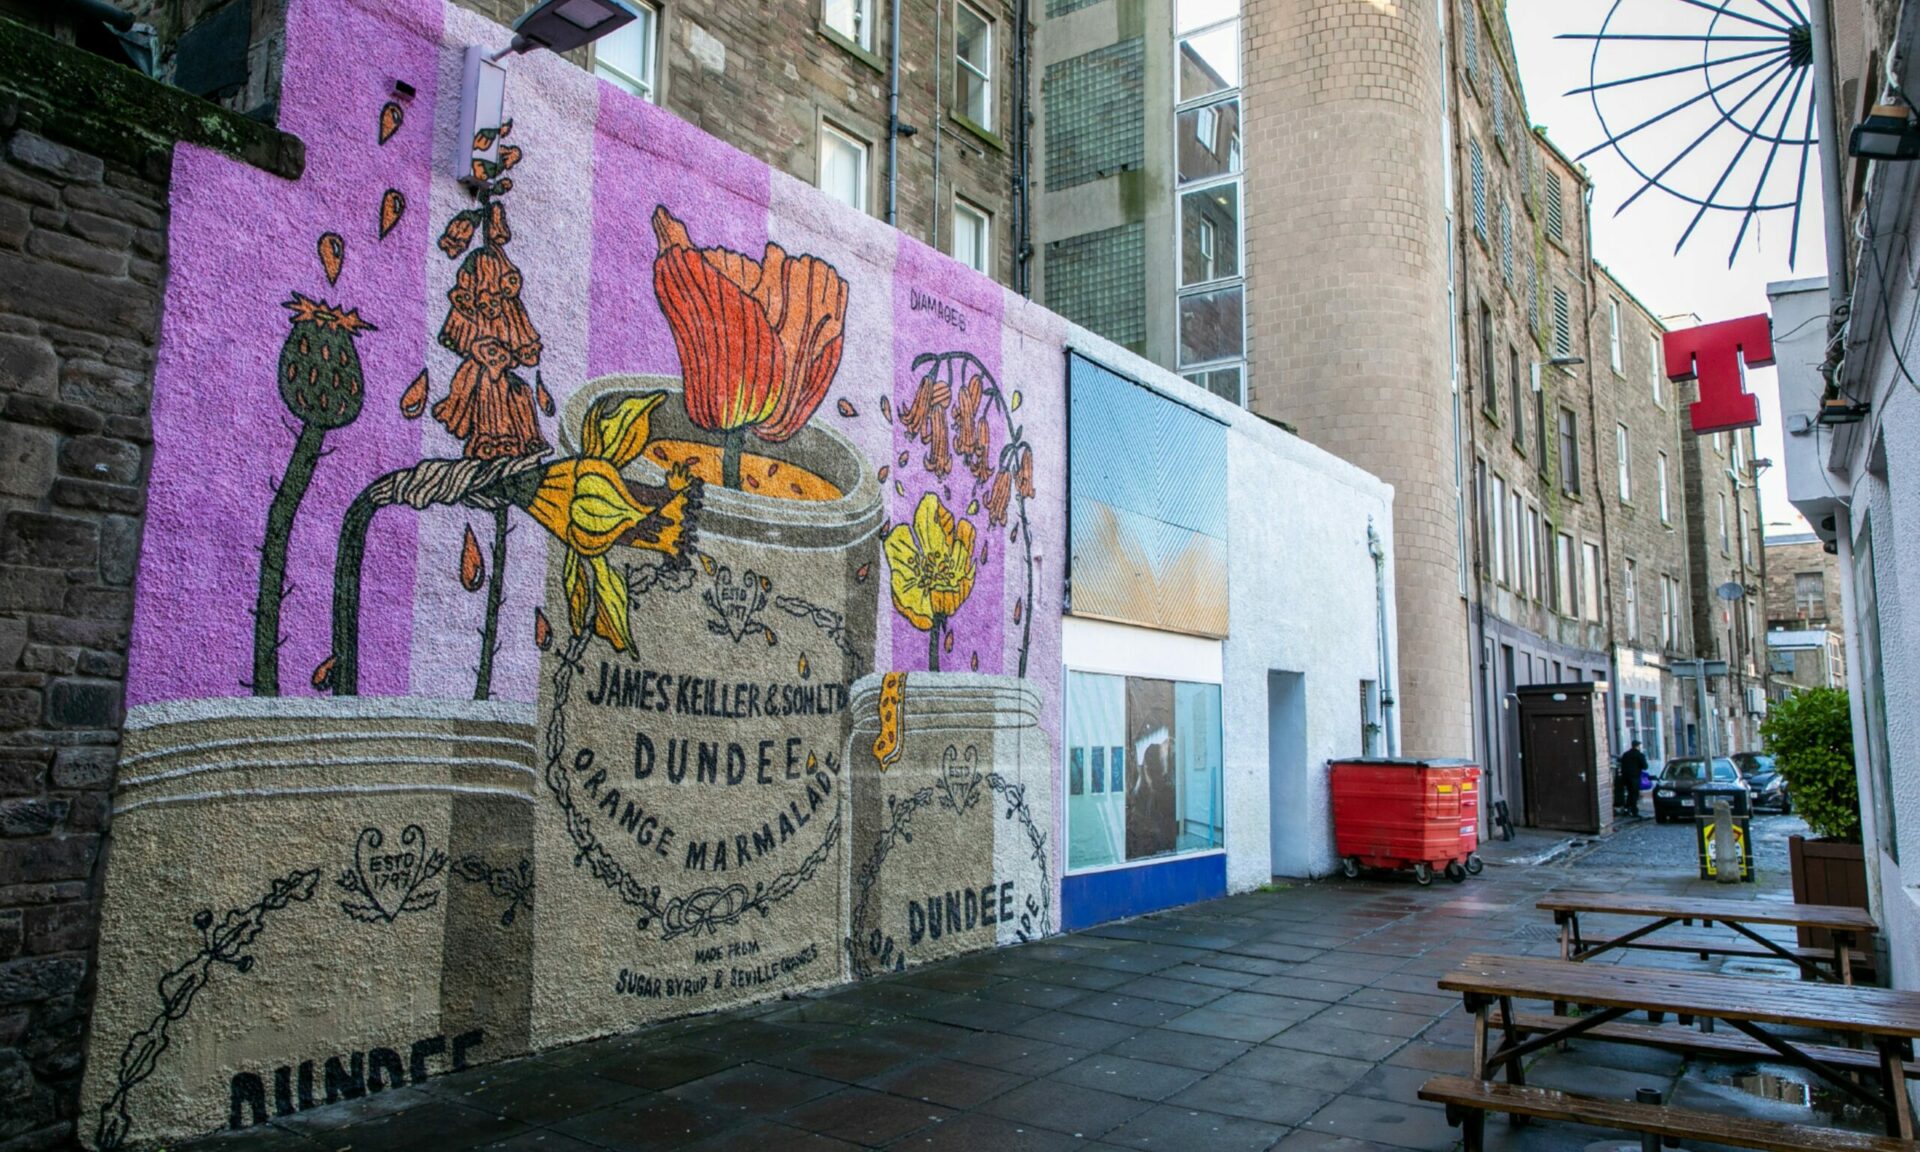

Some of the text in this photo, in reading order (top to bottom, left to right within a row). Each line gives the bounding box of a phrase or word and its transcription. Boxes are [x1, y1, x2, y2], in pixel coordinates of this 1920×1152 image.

[1663, 313, 1776, 435] T
[586, 661, 672, 713] JAMES
[676, 675, 761, 718] KEILLER
[764, 683, 780, 716] &
[782, 683, 814, 716] SON
[635, 732, 802, 785] DUNDEE
[574, 748, 840, 872] ORANGE MARMALADE
[909, 881, 1014, 945] DUNDEE
[616, 968, 661, 998] SUGAR
[731, 963, 778, 988] SEVILLE
[694, 945, 723, 965] MADE
